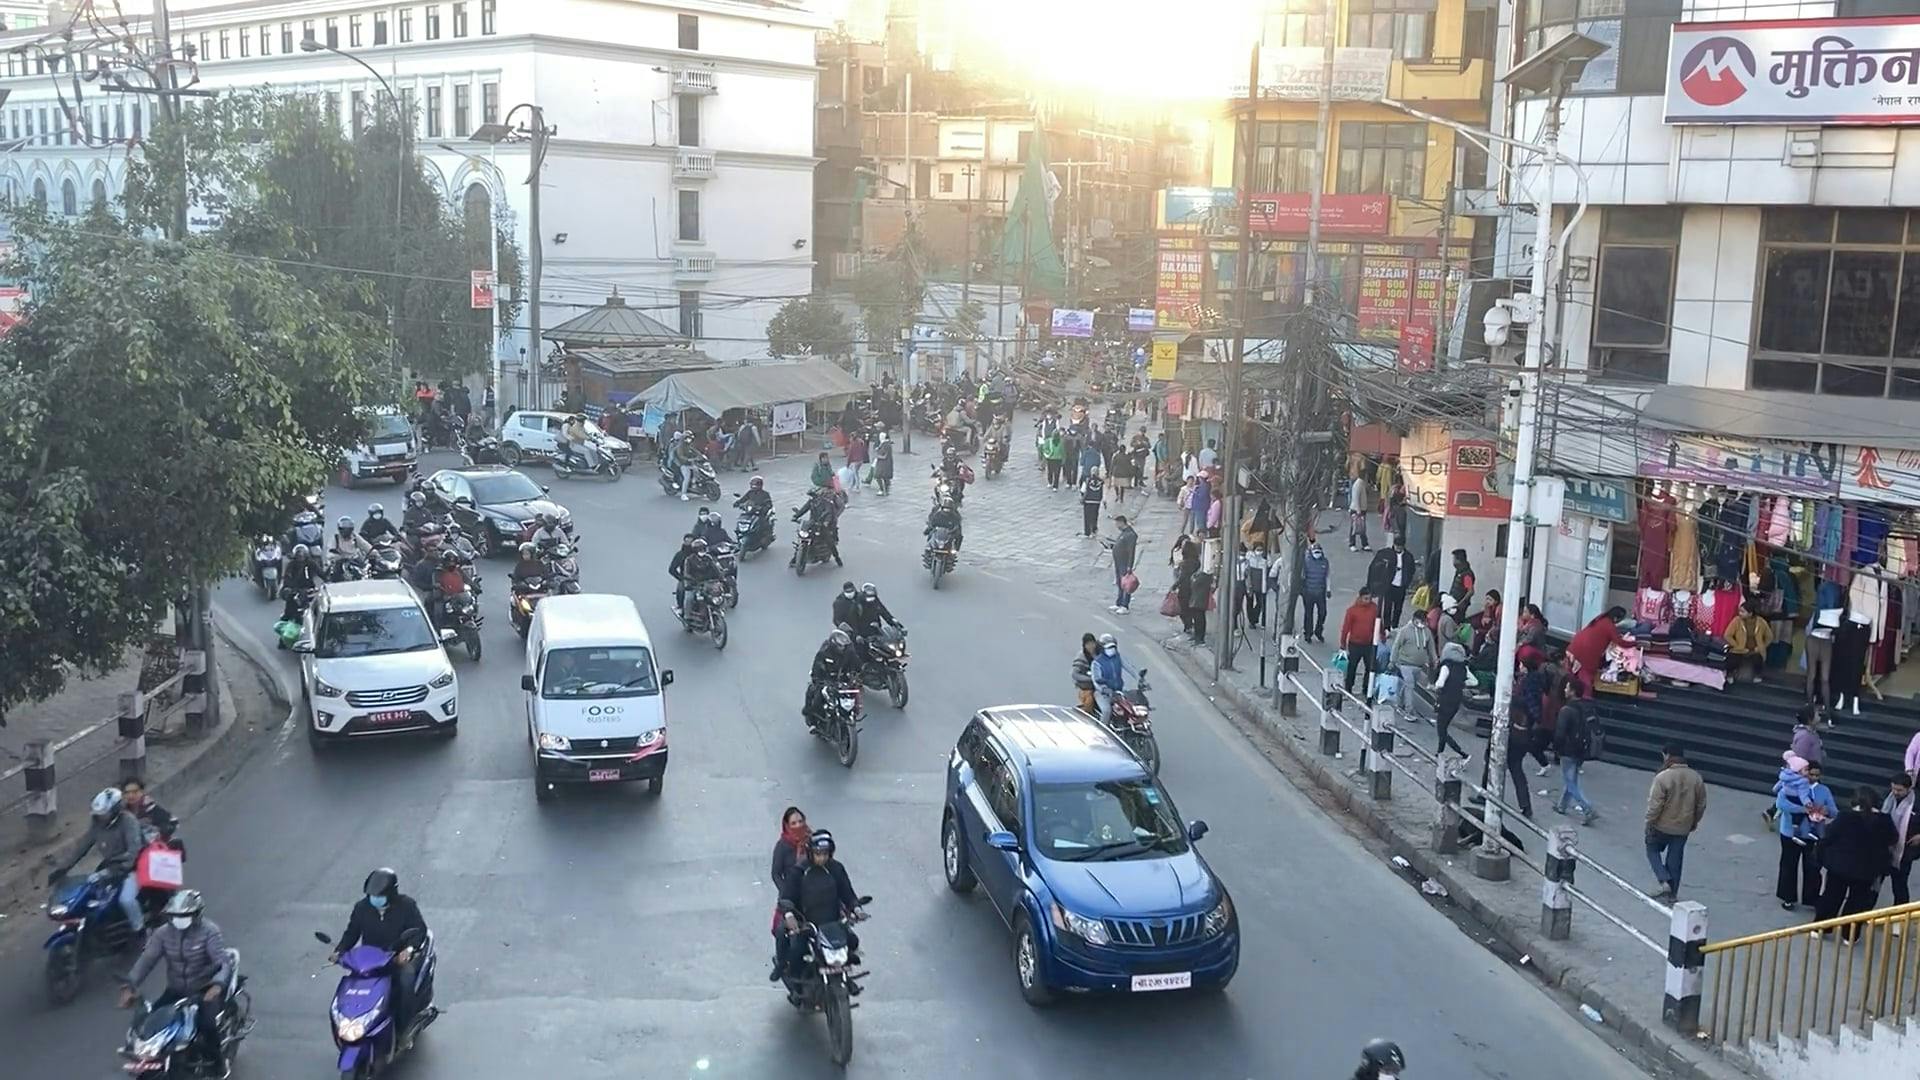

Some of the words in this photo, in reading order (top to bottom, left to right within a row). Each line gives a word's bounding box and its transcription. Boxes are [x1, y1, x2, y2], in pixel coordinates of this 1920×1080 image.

[1418, 269, 1464, 280] BAZAR
[1374, 298, 1395, 308] 1200
[1588, 542, 1606, 552] ATM
[582, 705, 624, 716] FOOD
